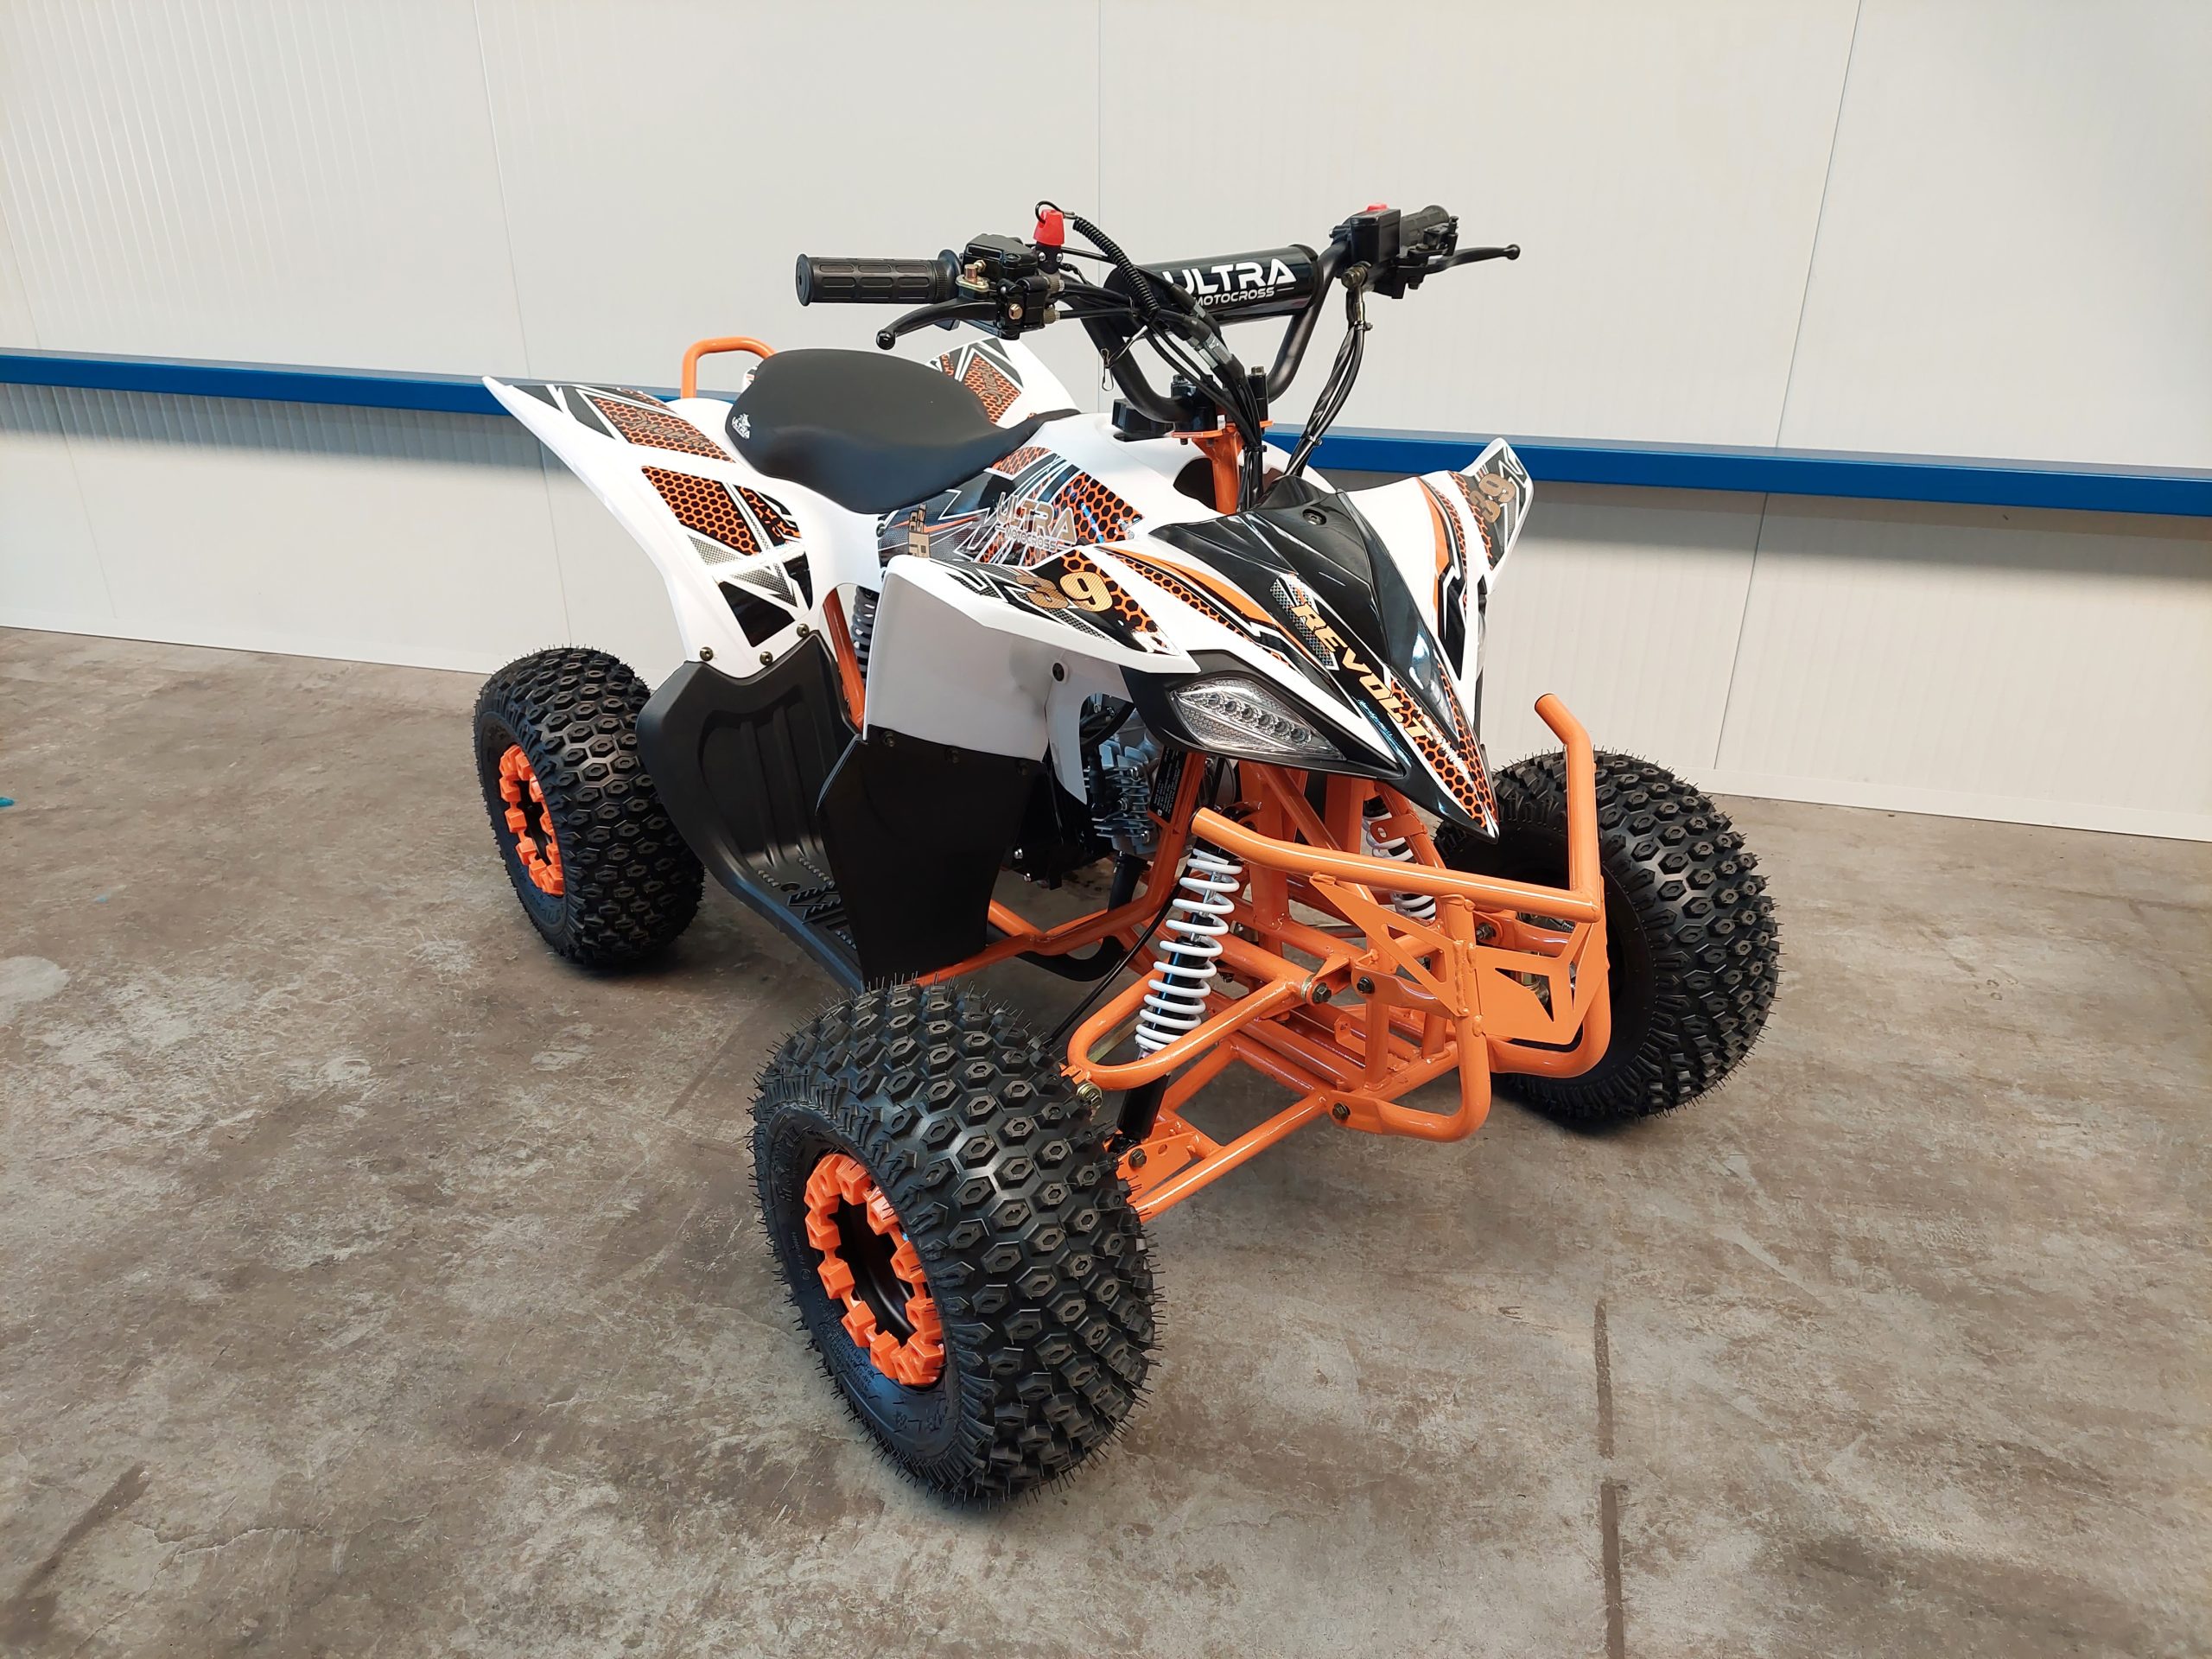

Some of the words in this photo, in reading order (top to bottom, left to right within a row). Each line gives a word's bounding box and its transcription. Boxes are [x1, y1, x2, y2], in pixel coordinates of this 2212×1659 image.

[1161, 258, 1296, 296] ULTRA
[1193, 287, 1274, 306] MOTOCROSS
[996, 492, 1077, 545] ULTRA
[1005, 526, 1058, 553] MOTOCROSS
[1015, 571, 1113, 612] 39
[1290, 604, 1433, 741] REVOLT
